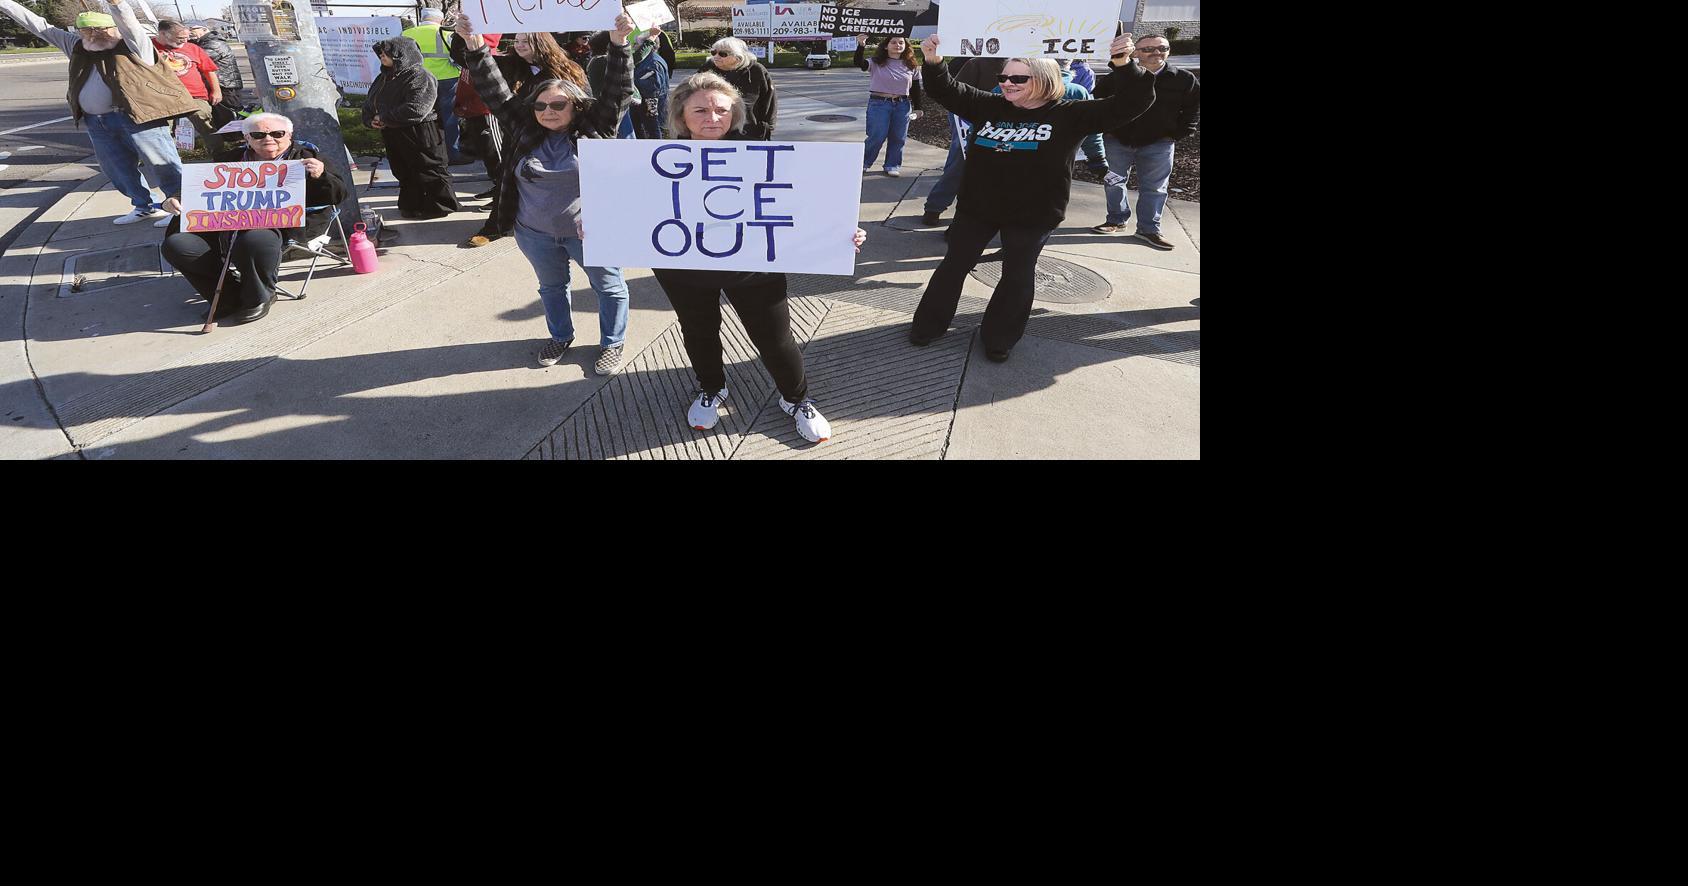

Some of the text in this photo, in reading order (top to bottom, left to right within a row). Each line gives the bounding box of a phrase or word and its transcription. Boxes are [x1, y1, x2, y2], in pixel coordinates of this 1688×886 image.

[822, 6, 838, 15] NO
[841, 8, 861, 16] ICE
[821, 14, 904, 26] NO VENEZUELA
[318, 26, 328, 34] AC
[338, 26, 390, 35] INDIVISIBLE
[733, 27, 769, 35] 209-983-1111
[773, 27, 820, 35] 209-983-1
[820, 22, 905, 34] NO GREENLAND
[960, 37, 1095, 56] NO ICE
[996, 121, 1013, 129] SAN
[651, 143, 795, 182] GET
[204, 162, 288, 189] STOP!
[201, 190, 291, 211] TRUMP
[671, 181, 793, 221] ICE
[188, 205, 301, 230] INSANITY
[651, 218, 794, 262] OUT
